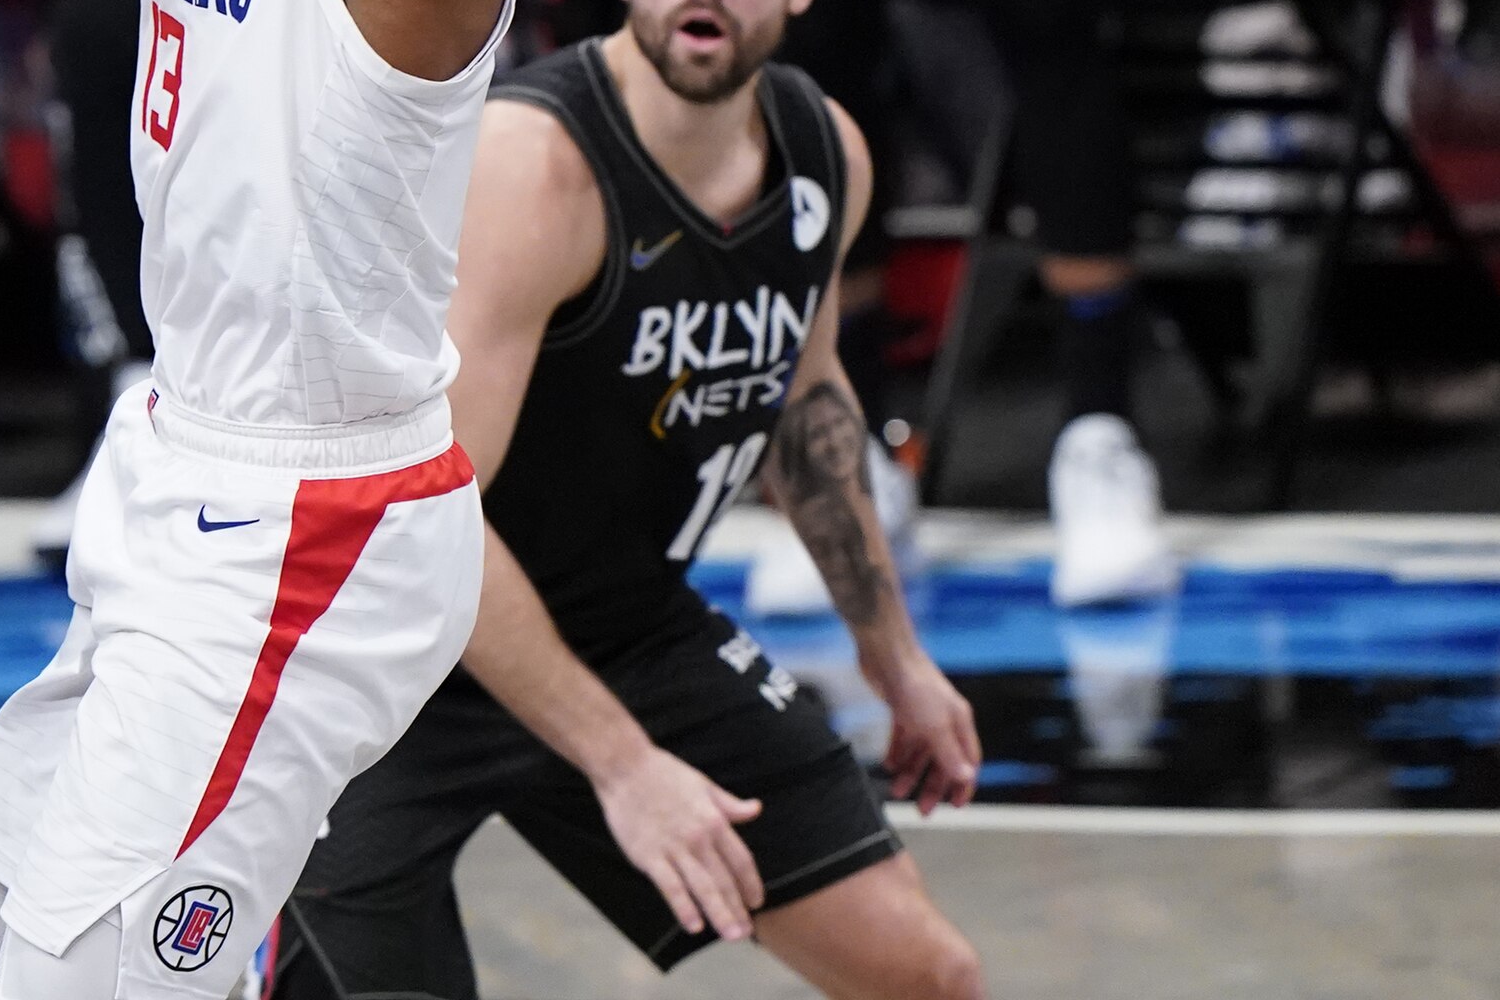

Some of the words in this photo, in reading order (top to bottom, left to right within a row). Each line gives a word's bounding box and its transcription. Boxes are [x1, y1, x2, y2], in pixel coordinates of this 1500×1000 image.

[142, 0, 185, 152] 13
[621, 284, 820, 381] BKLYN
[664, 360, 792, 428] NETS
